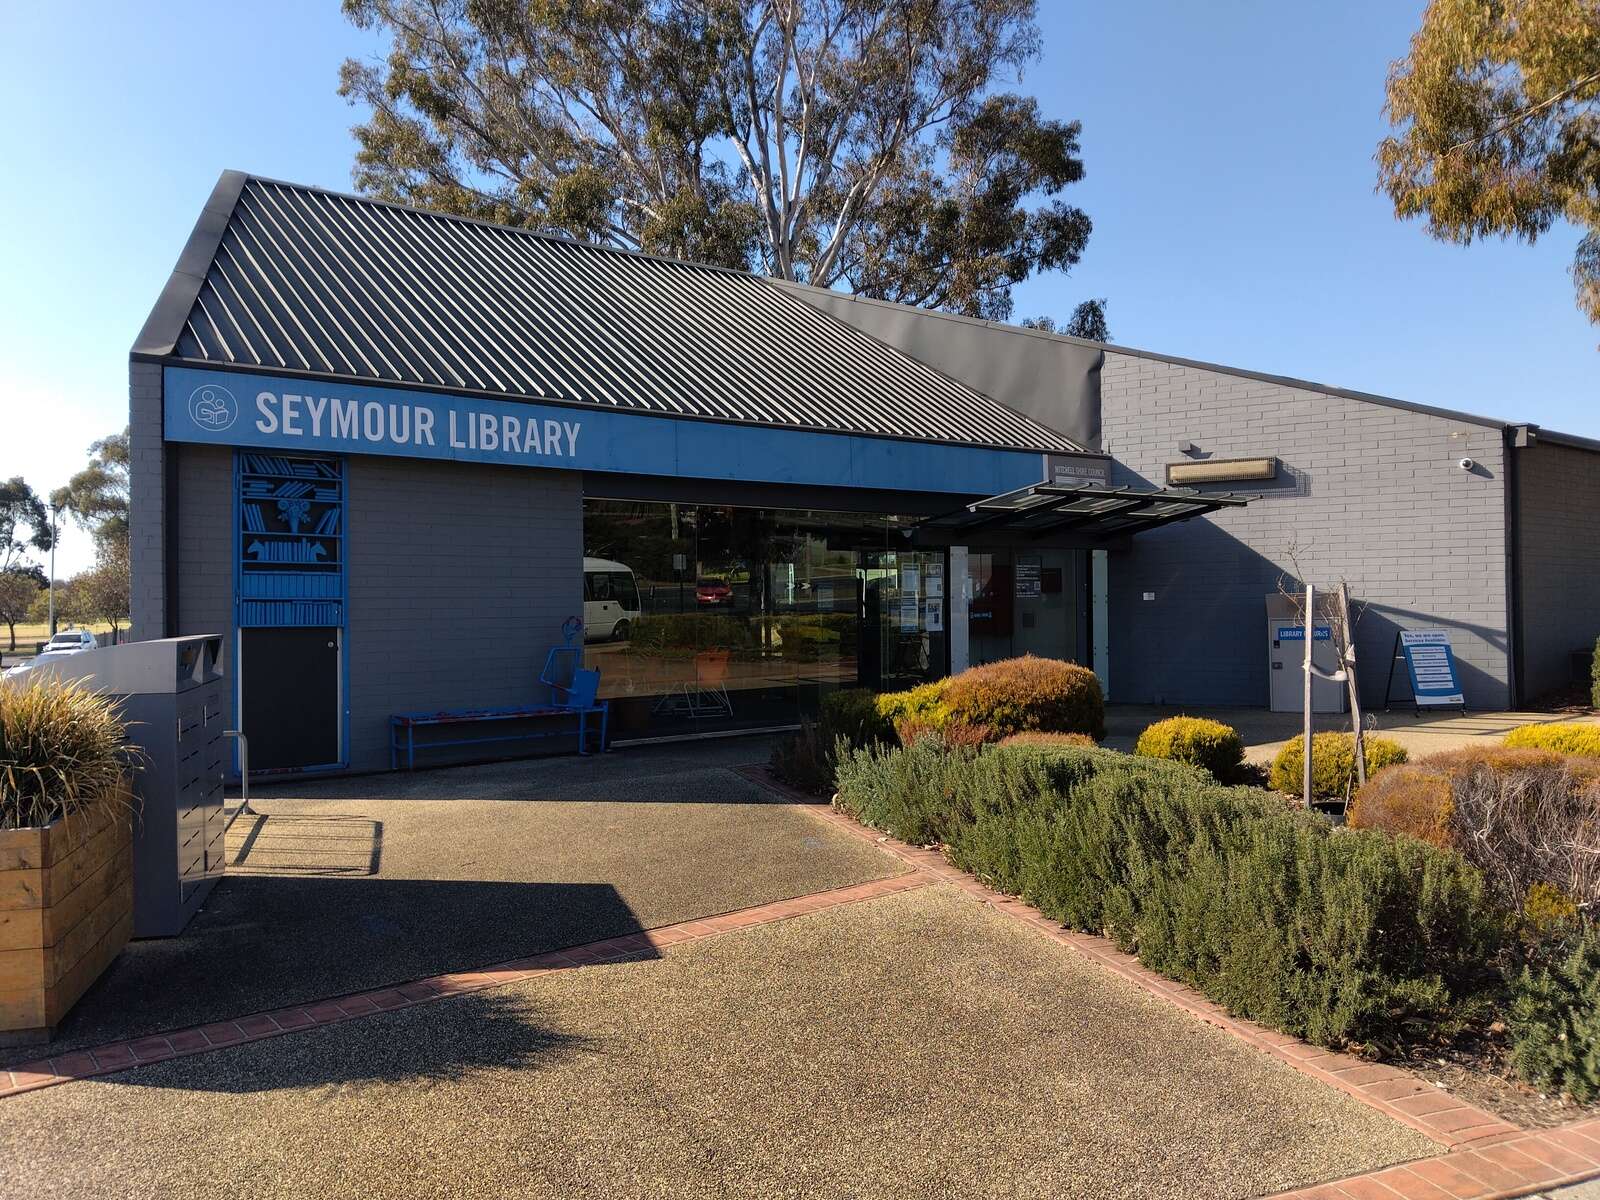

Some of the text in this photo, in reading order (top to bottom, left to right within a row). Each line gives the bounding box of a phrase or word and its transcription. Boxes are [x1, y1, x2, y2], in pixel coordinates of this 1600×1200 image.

[255, 391, 581, 457] SEYMOUR LIBRARY
[1280, 630, 1303, 638] LIBRARY
